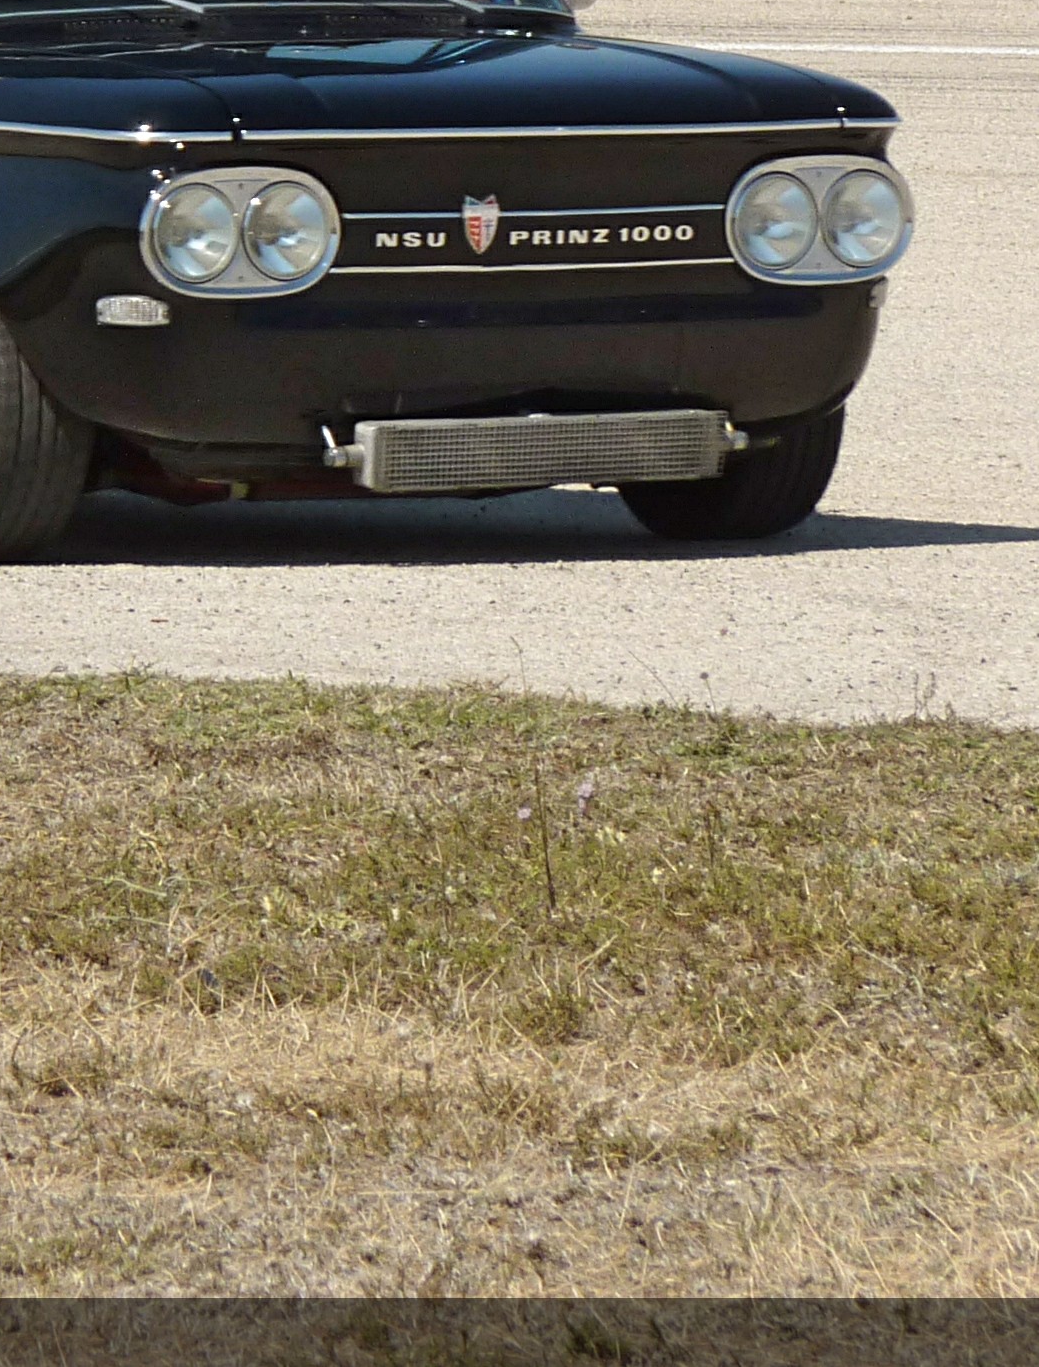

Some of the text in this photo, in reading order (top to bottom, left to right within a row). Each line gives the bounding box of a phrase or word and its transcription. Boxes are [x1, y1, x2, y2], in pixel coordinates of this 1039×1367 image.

[375, 224, 695, 248] NSU PRINZ 1000
